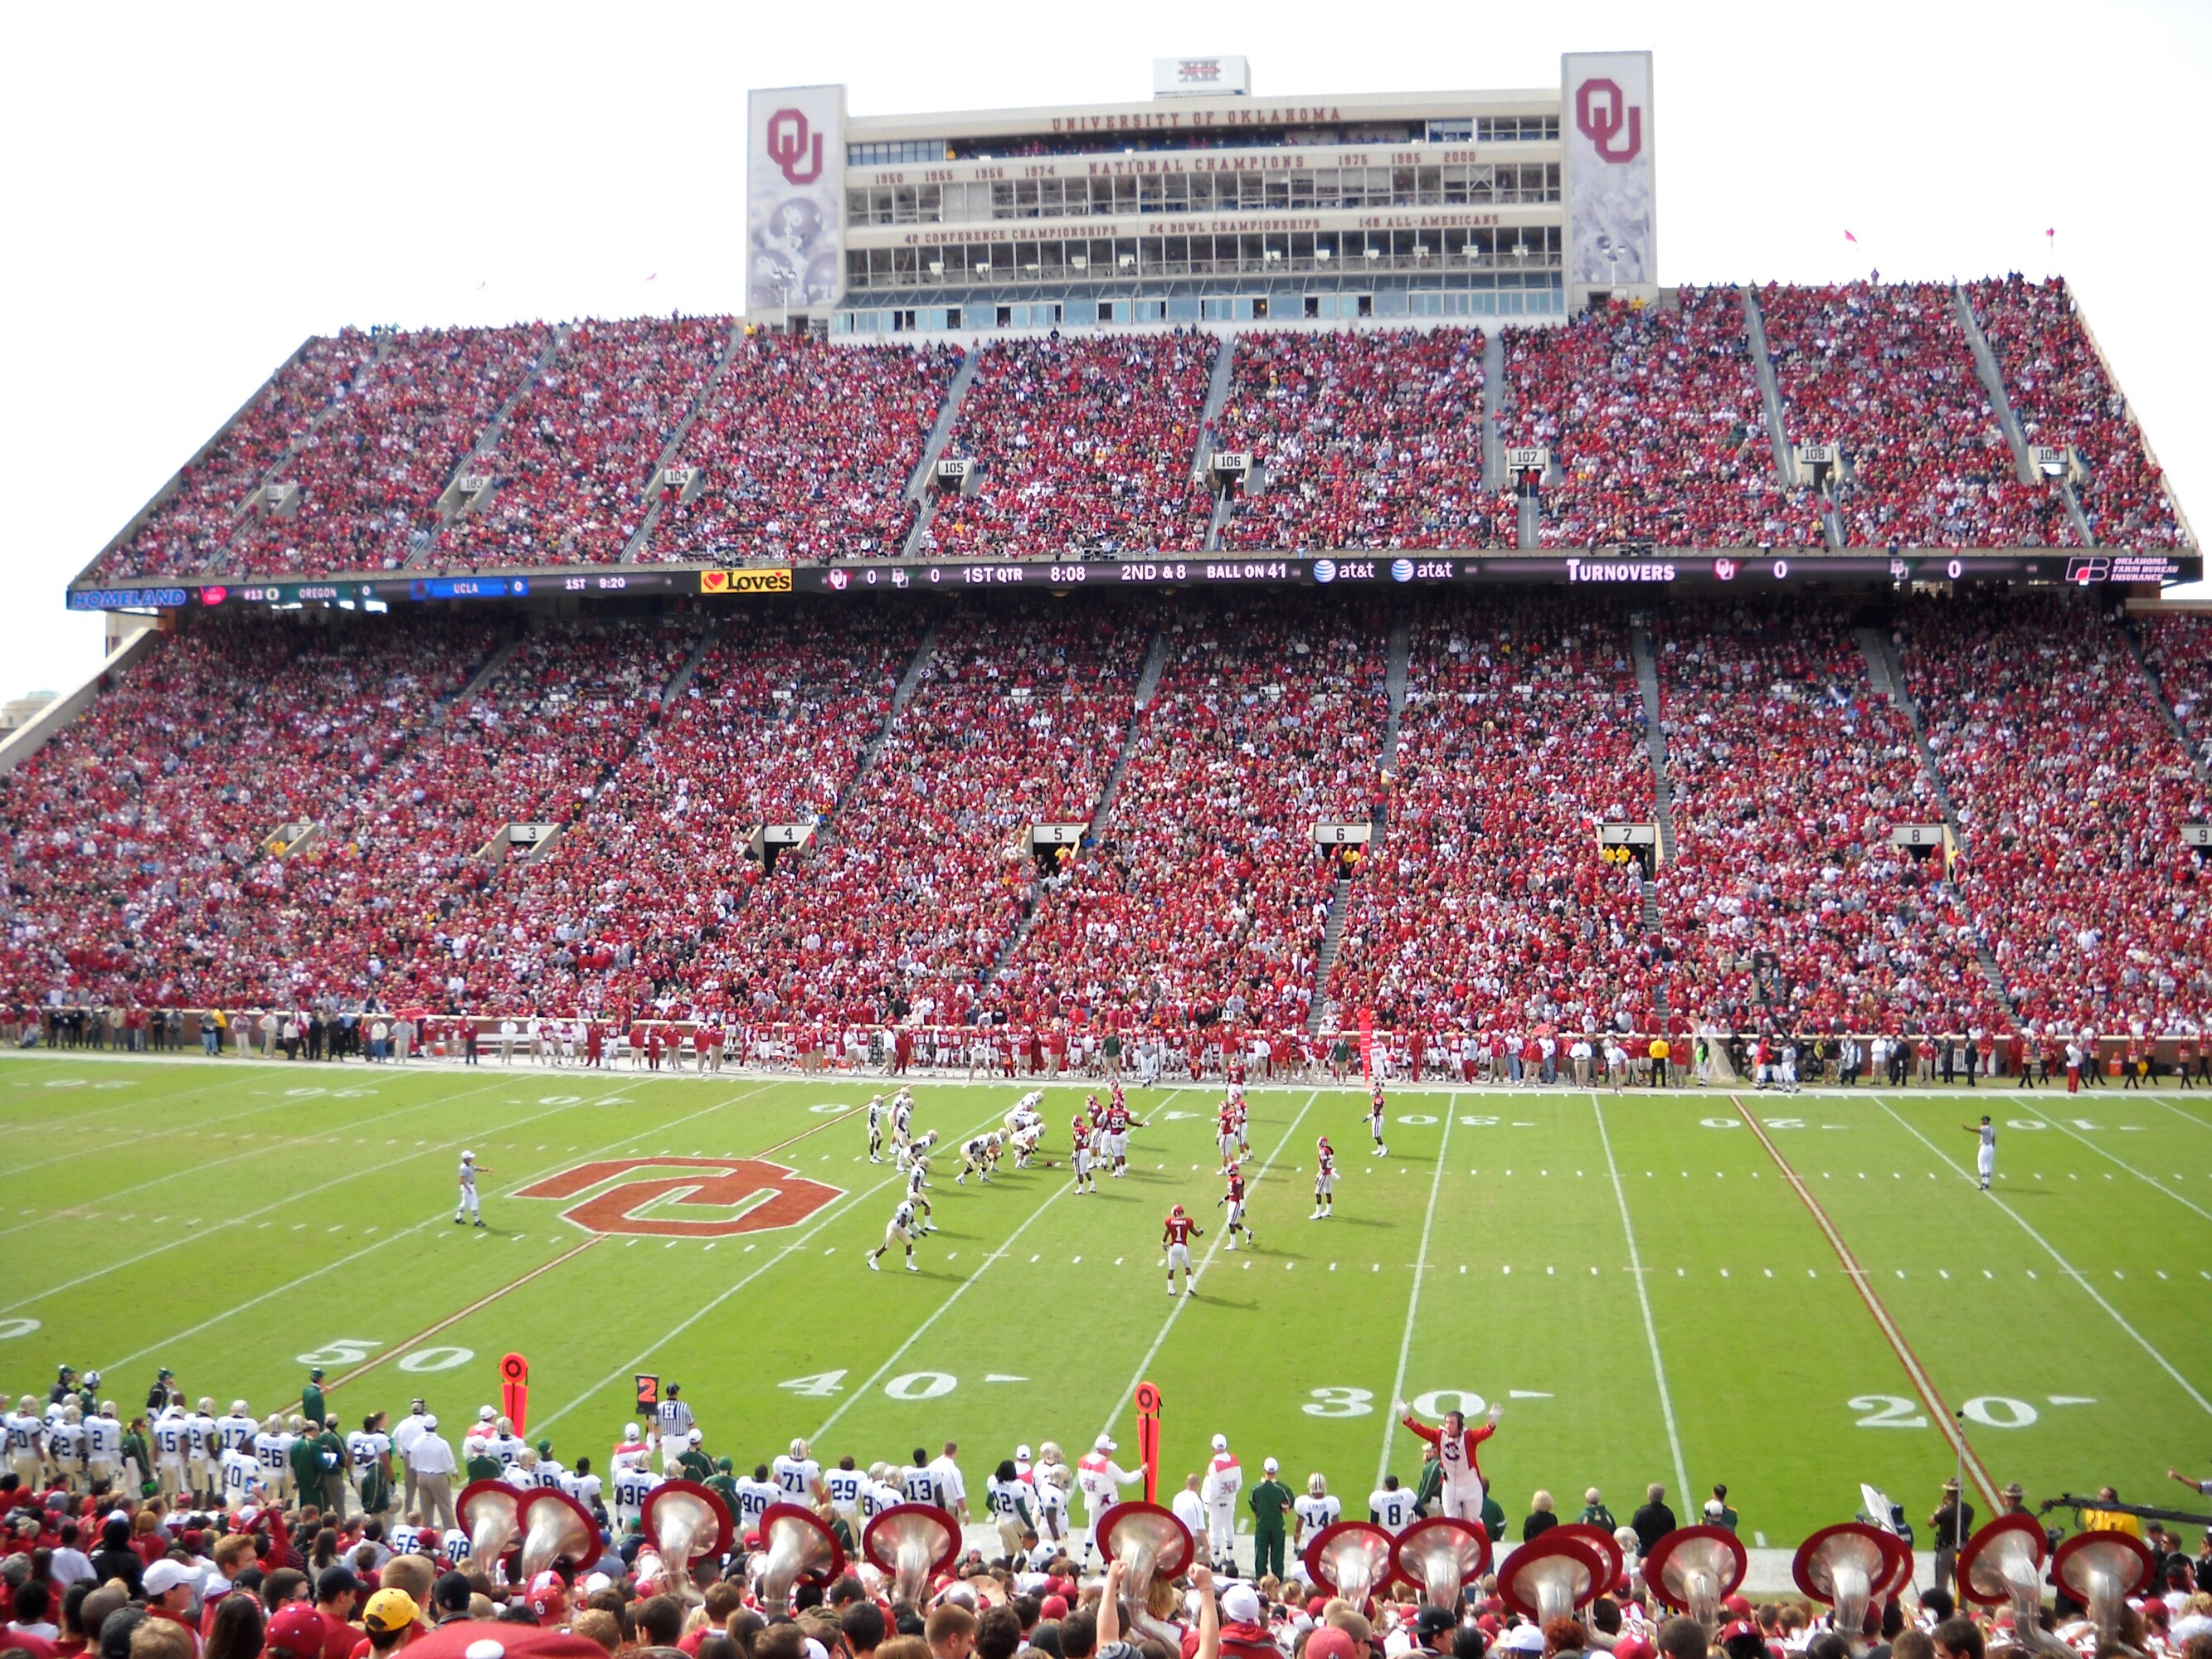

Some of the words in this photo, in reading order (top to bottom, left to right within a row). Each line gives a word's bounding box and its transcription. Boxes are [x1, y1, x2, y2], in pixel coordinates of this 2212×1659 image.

[1053, 113, 1180, 132] UNIVERSITY
[1194, 111, 1214, 125] OF
[1228, 107, 1341, 124] OKLAHOMA
[1576, 78, 1641, 163] OU
[767, 109, 823, 185] OU
[1339, 154, 1368, 166] 1975
[1391, 153, 1421, 163] 1985
[1444, 151, 1475, 163] 2000
[1025, 166, 1055, 178] 1974
[1089, 159, 1184, 174] NATIONAL
[1195, 156, 1304, 170] CHAMPIONS
[875, 173, 904, 184] 1950
[925, 170, 954, 182] 1955
[975, 168, 1004, 179] 1956
[1150, 224, 1163, 234] 24
[1170, 222, 1205, 233] BOWL
[1212, 219, 1320, 231] CHAMPIONSHIPS
[1388, 214, 1499, 226] ALL-AMERICANS
[926, 229, 1005, 243] CONFERENCE
[1012, 226, 1117, 240] CHAMPIONSHIPS
[1222, 456, 1241, 467] 106
[1516, 451, 1537, 463] 107
[1805, 448, 1825, 460] 108
[944, 462, 964, 474] 105
[669, 470, 688, 482] 104
[2114, 557, 2168, 566] OKLAHOMA
[2142, 565, 2180, 573] BUREAU
[867, 569, 877, 585] 0
[931, 568, 940, 584] 0
[963, 567, 994, 583] 1ST
[997, 568, 1023, 581] QTR
[1050, 566, 1086, 581] 8:08
[1121, 564, 1157, 581] 2ND
[1162, 565, 1174, 579] &
[1176, 564, 1187, 579] 8
[1207, 565, 1241, 578] BALL
[1244, 565, 1265, 578] ON
[1267, 563, 1286, 578] 41
[1339, 562, 1374, 579] at&t
[1417, 562, 1452, 578] at&t
[1774, 560, 1787, 579] 0
[1947, 560, 1962, 579] 0
[454, 582, 479, 596] UCLA
[514, 581, 523, 592] 0
[566, 578, 586, 591] 1ST
[600, 577, 626, 589] 9:20
[72, 589, 186, 609] HOMELAND
[299, 587, 337, 599] OREGON
[362, 586, 371, 596] 0
[528, 827, 536, 839] 3
[784, 827, 793, 839] 4
[1054, 828, 1062, 839] 5
[1336, 828, 1344, 841] 6
[1623, 829, 1632, 841] 7
[1912, 830, 1920, 842] 8
[2200, 830, 2207, 843] 9
[1111, 1117, 1125, 1128] 93
[1175, 1226, 1182, 1241] 1
[296, 1339, 474, 1372] 50
[638, 1378, 656, 1403] 2
[777, 1370, 958, 1400] 40
[1302, 1387, 1485, 1419] 30
[664, 1404, 676, 1419] H
[1848, 1394, 2038, 1428] 20
[225, 1428, 247, 1449] 17
[260, 1447, 284, 1467] 26
[783, 1472, 805, 1492] 71
[831, 1480, 858, 1501] 29
[908, 1479, 933, 1501] 13
[1306, 1511, 1329, 1528] 14
[1388, 1504, 1401, 1525] 8
